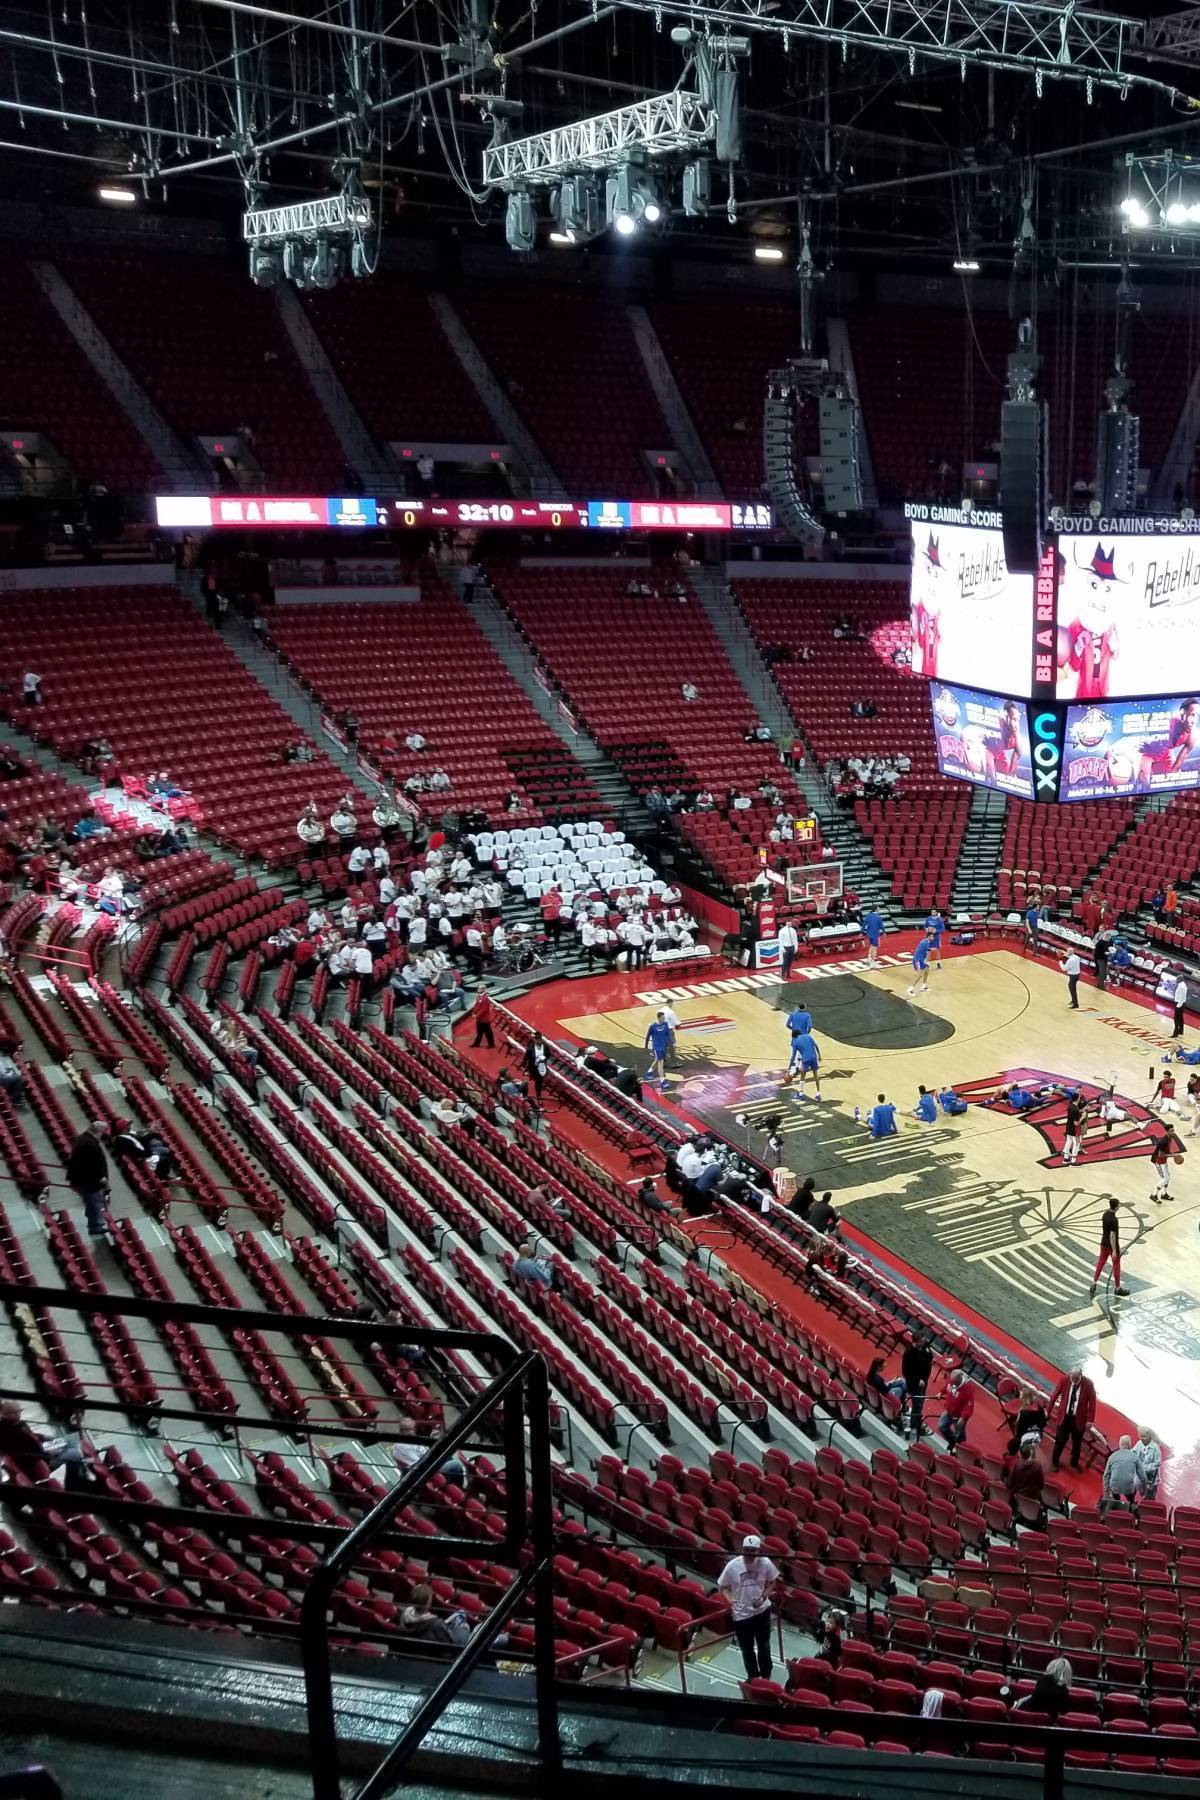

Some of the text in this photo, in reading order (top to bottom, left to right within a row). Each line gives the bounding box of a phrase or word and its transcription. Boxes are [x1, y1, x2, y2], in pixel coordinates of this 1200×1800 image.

[404, 511, 415, 525] 0
[458, 504, 513, 521] 32:10
[552, 512, 562, 526] 0
[904, 503, 1003, 528] BOYD GAMING SCORE
[1054, 518, 1093, 533] BOYD
[1098, 518, 1155, 533] GAMING
[1036, 546, 1054, 682] BE A REBEL.
[1034, 713, 1060, 791] COX
[798, 828, 813, 841] 30
